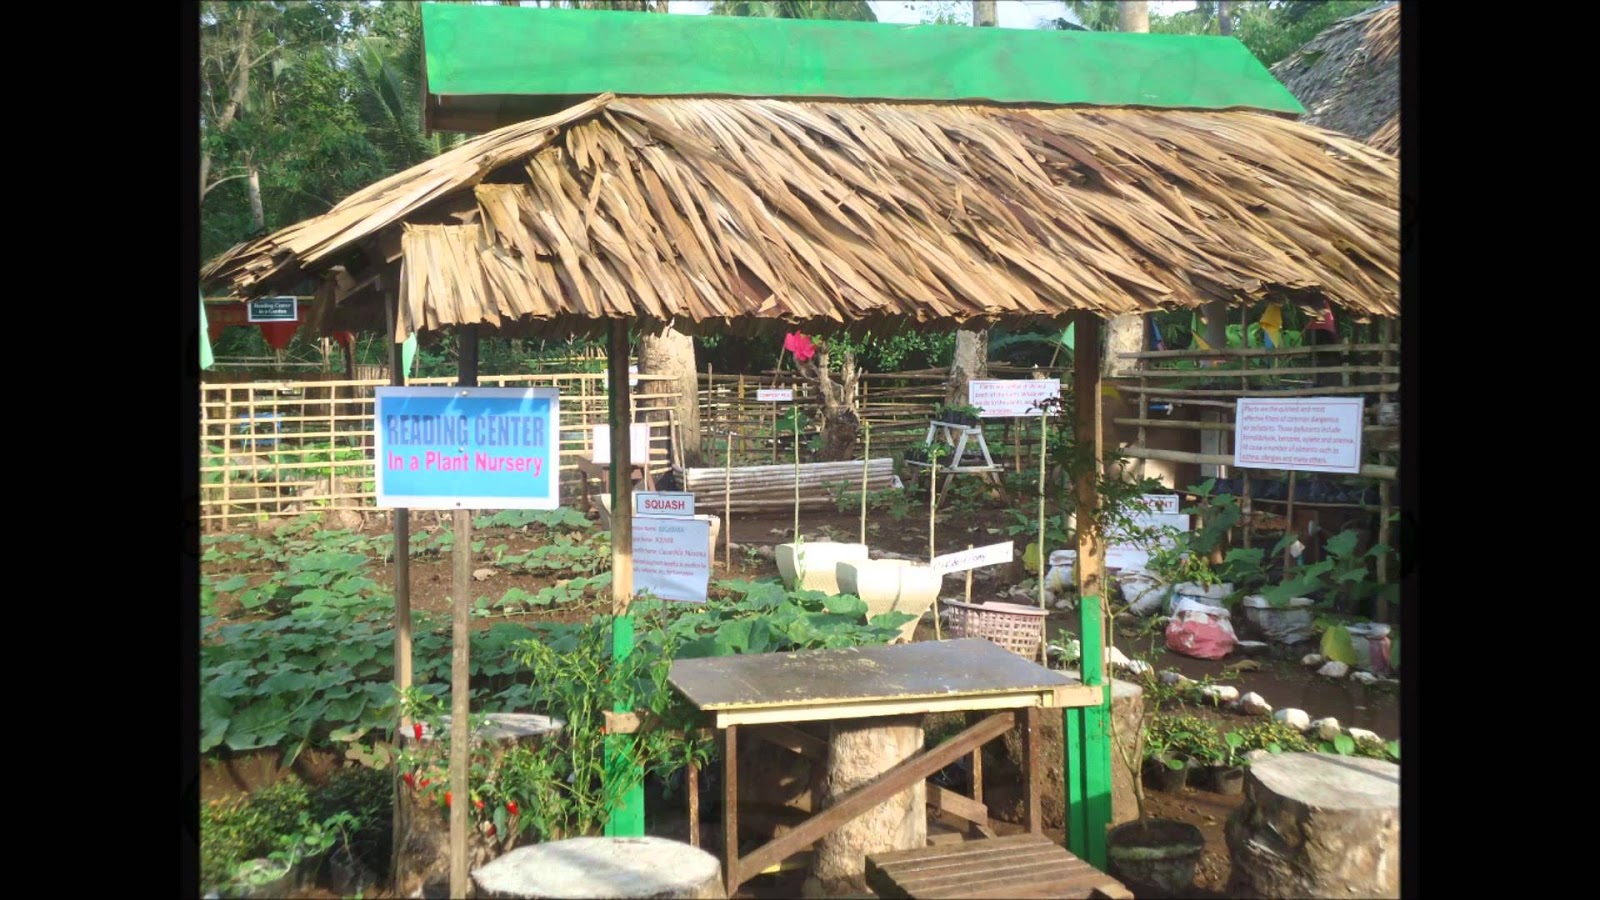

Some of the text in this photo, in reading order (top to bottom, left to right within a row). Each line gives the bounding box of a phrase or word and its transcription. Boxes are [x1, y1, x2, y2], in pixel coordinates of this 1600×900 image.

[387, 414, 544, 446] READING CENTER
[388, 451, 543, 477] In a Plant Nursery
[645, 499, 685, 510] SQUASH
